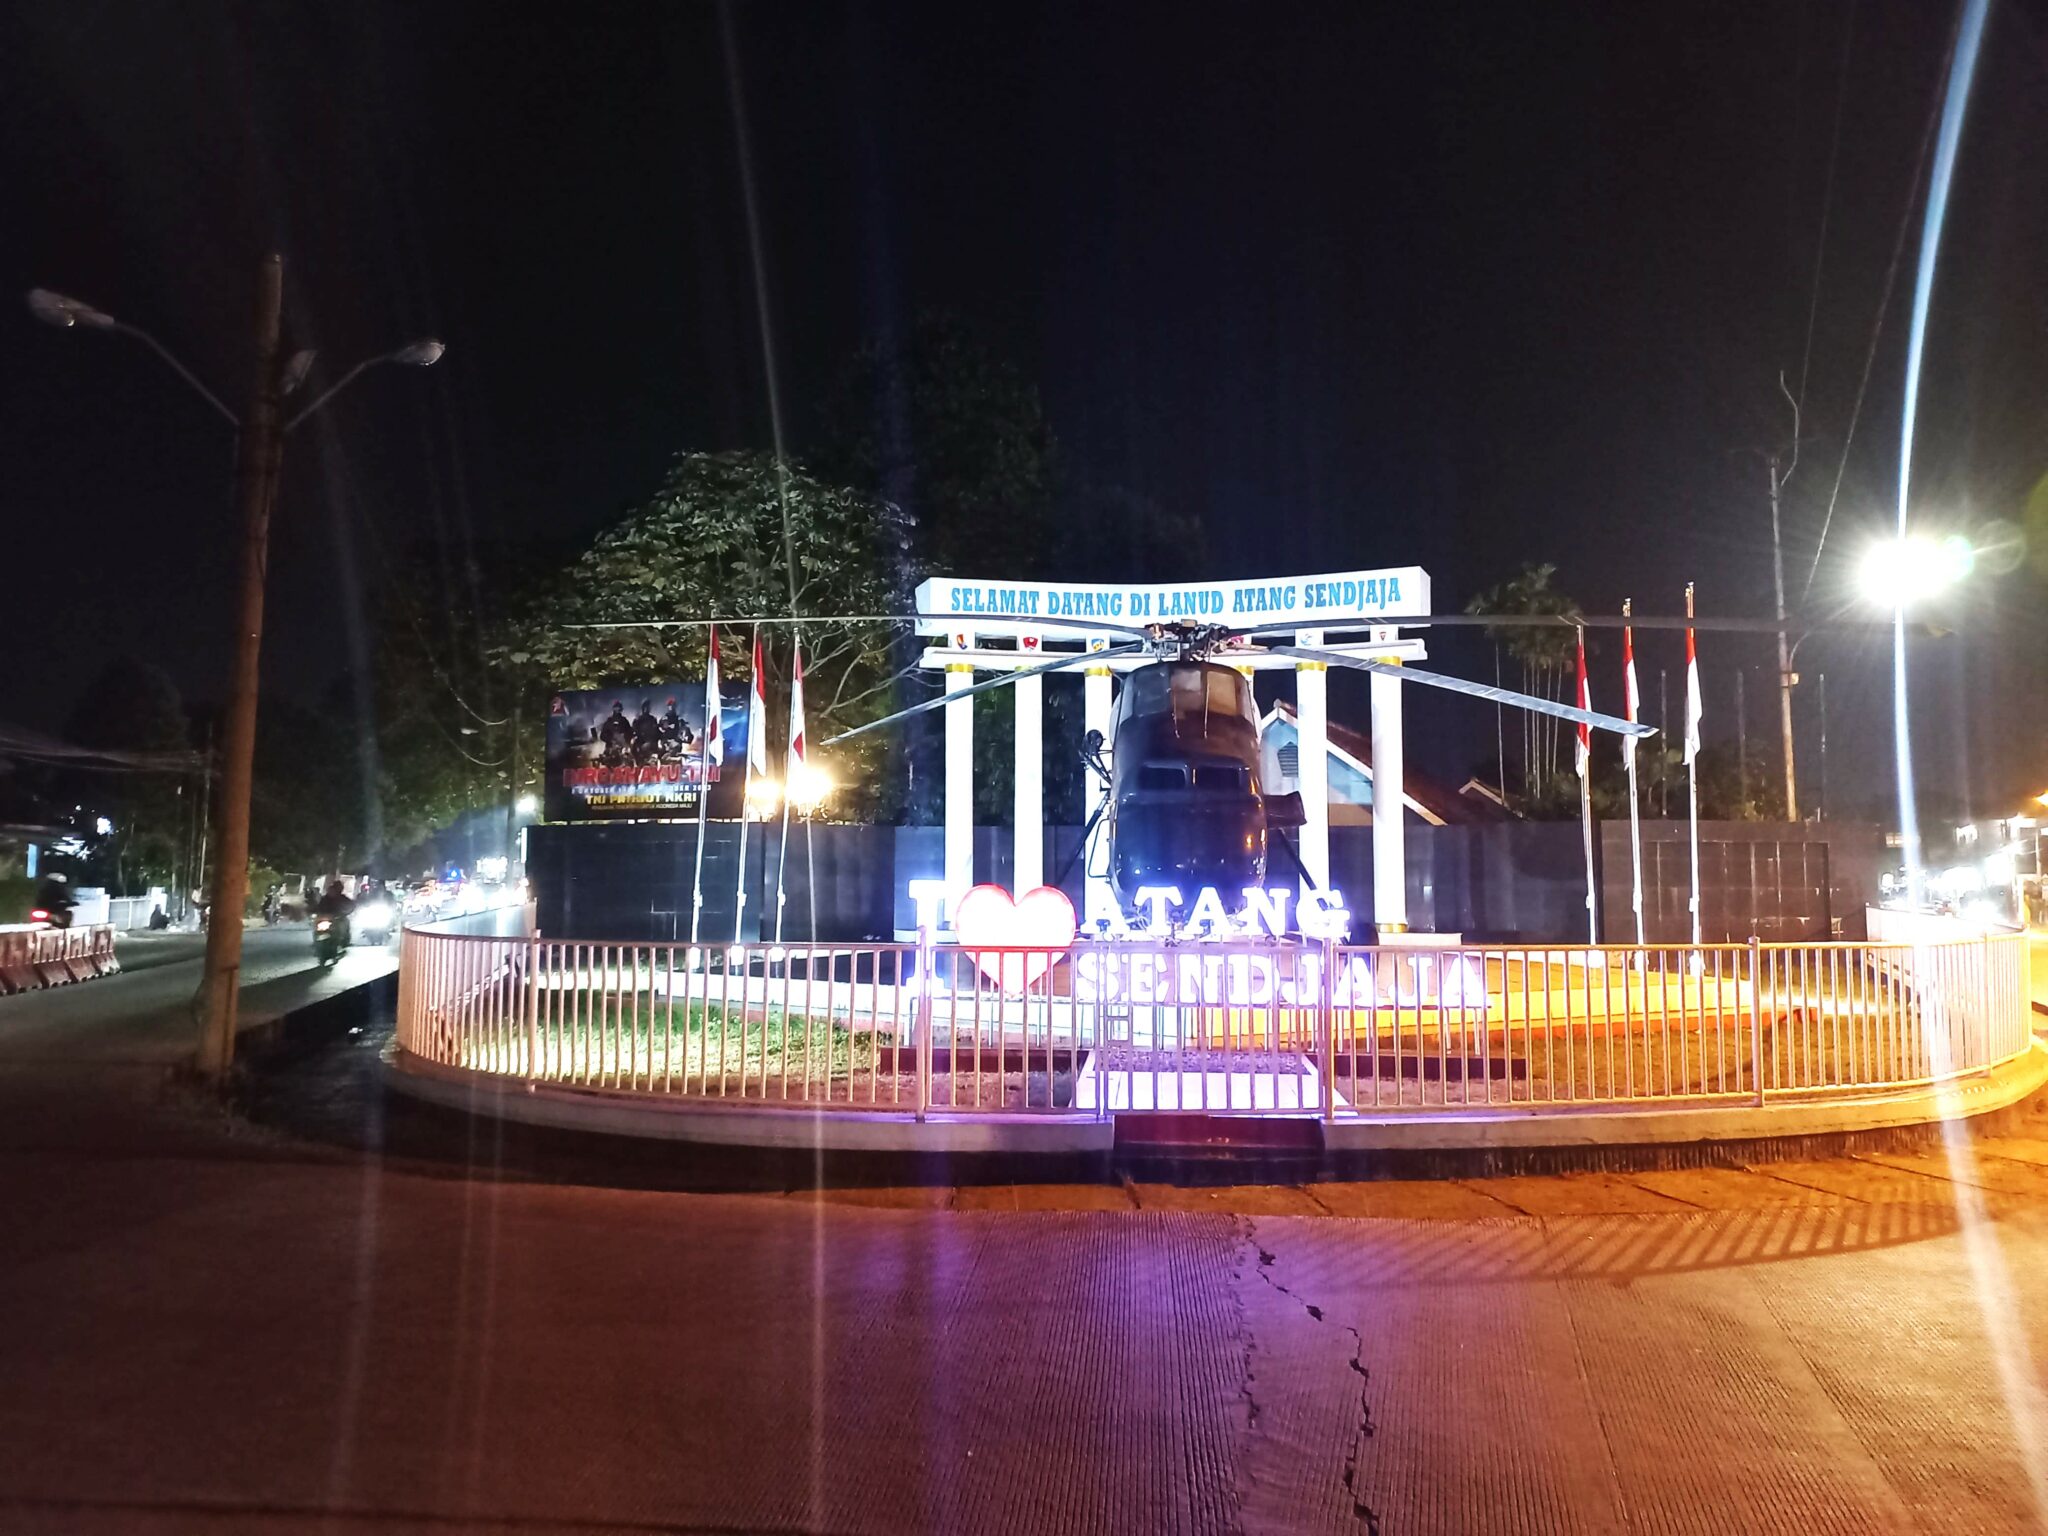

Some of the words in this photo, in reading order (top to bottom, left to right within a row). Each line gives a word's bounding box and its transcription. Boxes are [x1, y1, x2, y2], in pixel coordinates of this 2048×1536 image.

[951, 587, 1040, 614] SELAMAT
[1047, 591, 1123, 616] DATANG
[1130, 593, 1151, 616] DI
[1158, 590, 1224, 616] LANUD
[1232, 585, 1296, 613] ATANG
[1304, 577, 1401, 612] SENDJAJA
[585, 794, 606, 805] TNI
[665, 792, 698, 803] NKRI
[905, 880, 948, 997] I
[1080, 885, 1351, 939] ATANG
[1075, 951, 1490, 1007] SENDJAJA
